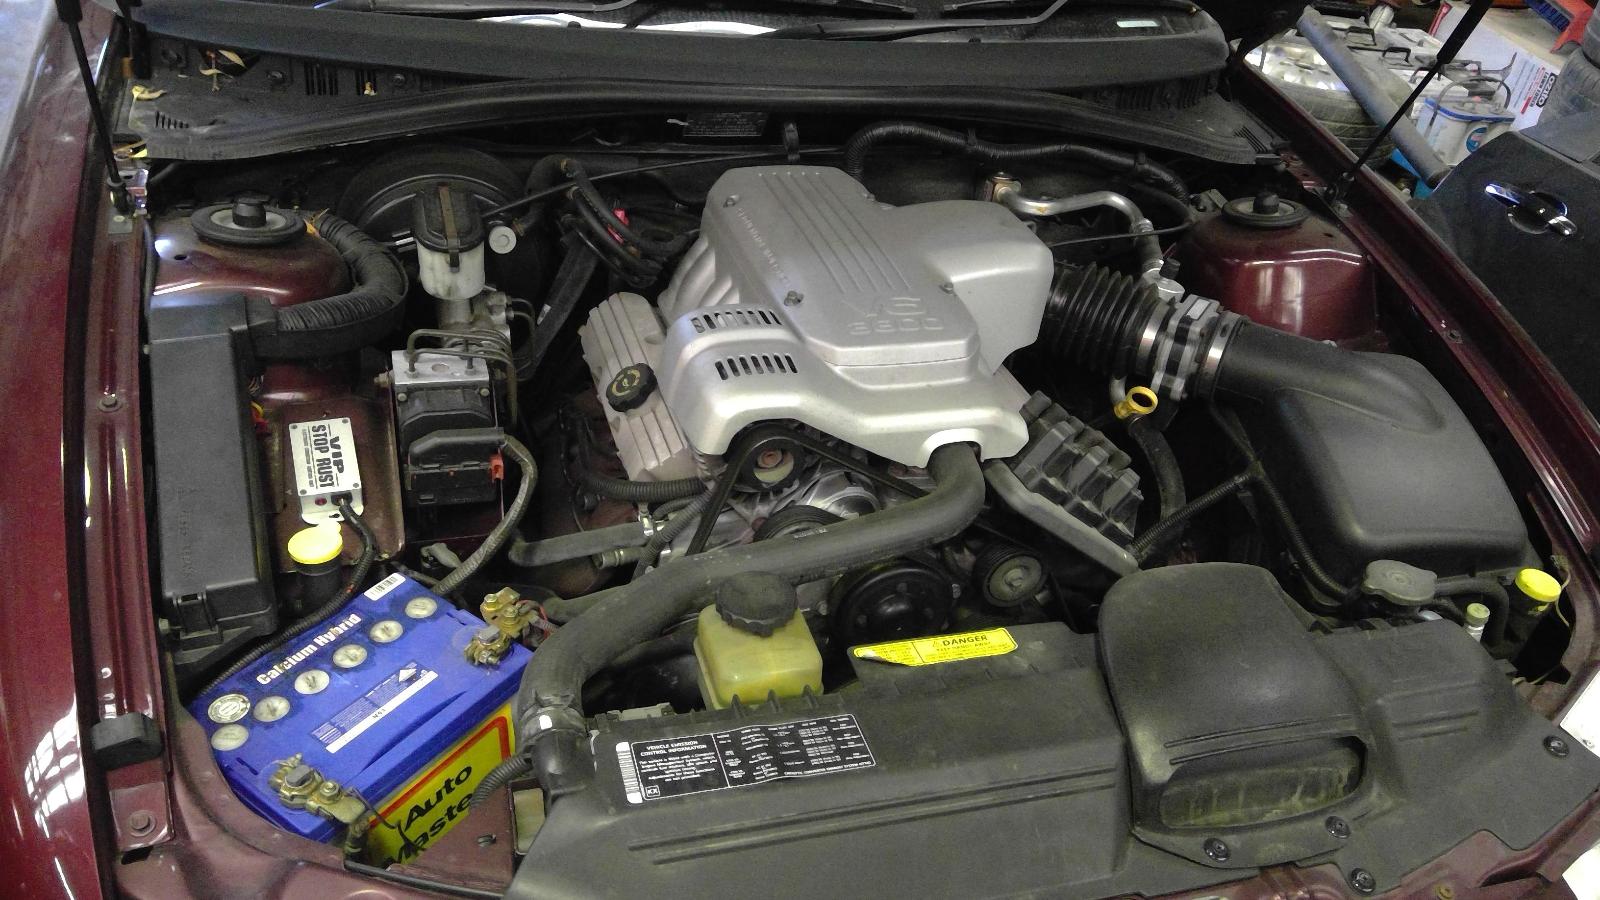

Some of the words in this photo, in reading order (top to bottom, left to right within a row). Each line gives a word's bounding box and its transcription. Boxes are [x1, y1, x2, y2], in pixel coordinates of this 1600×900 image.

[312, 425, 329, 453] STOP
[330, 435, 344, 473] VIP
[316, 458, 334, 487] RUST
[256, 643, 318, 685] Calcium
[313, 613, 362, 647] Hybrid
[943, 635, 988, 646] DANGER
[404, 766, 472, 832] Auto
